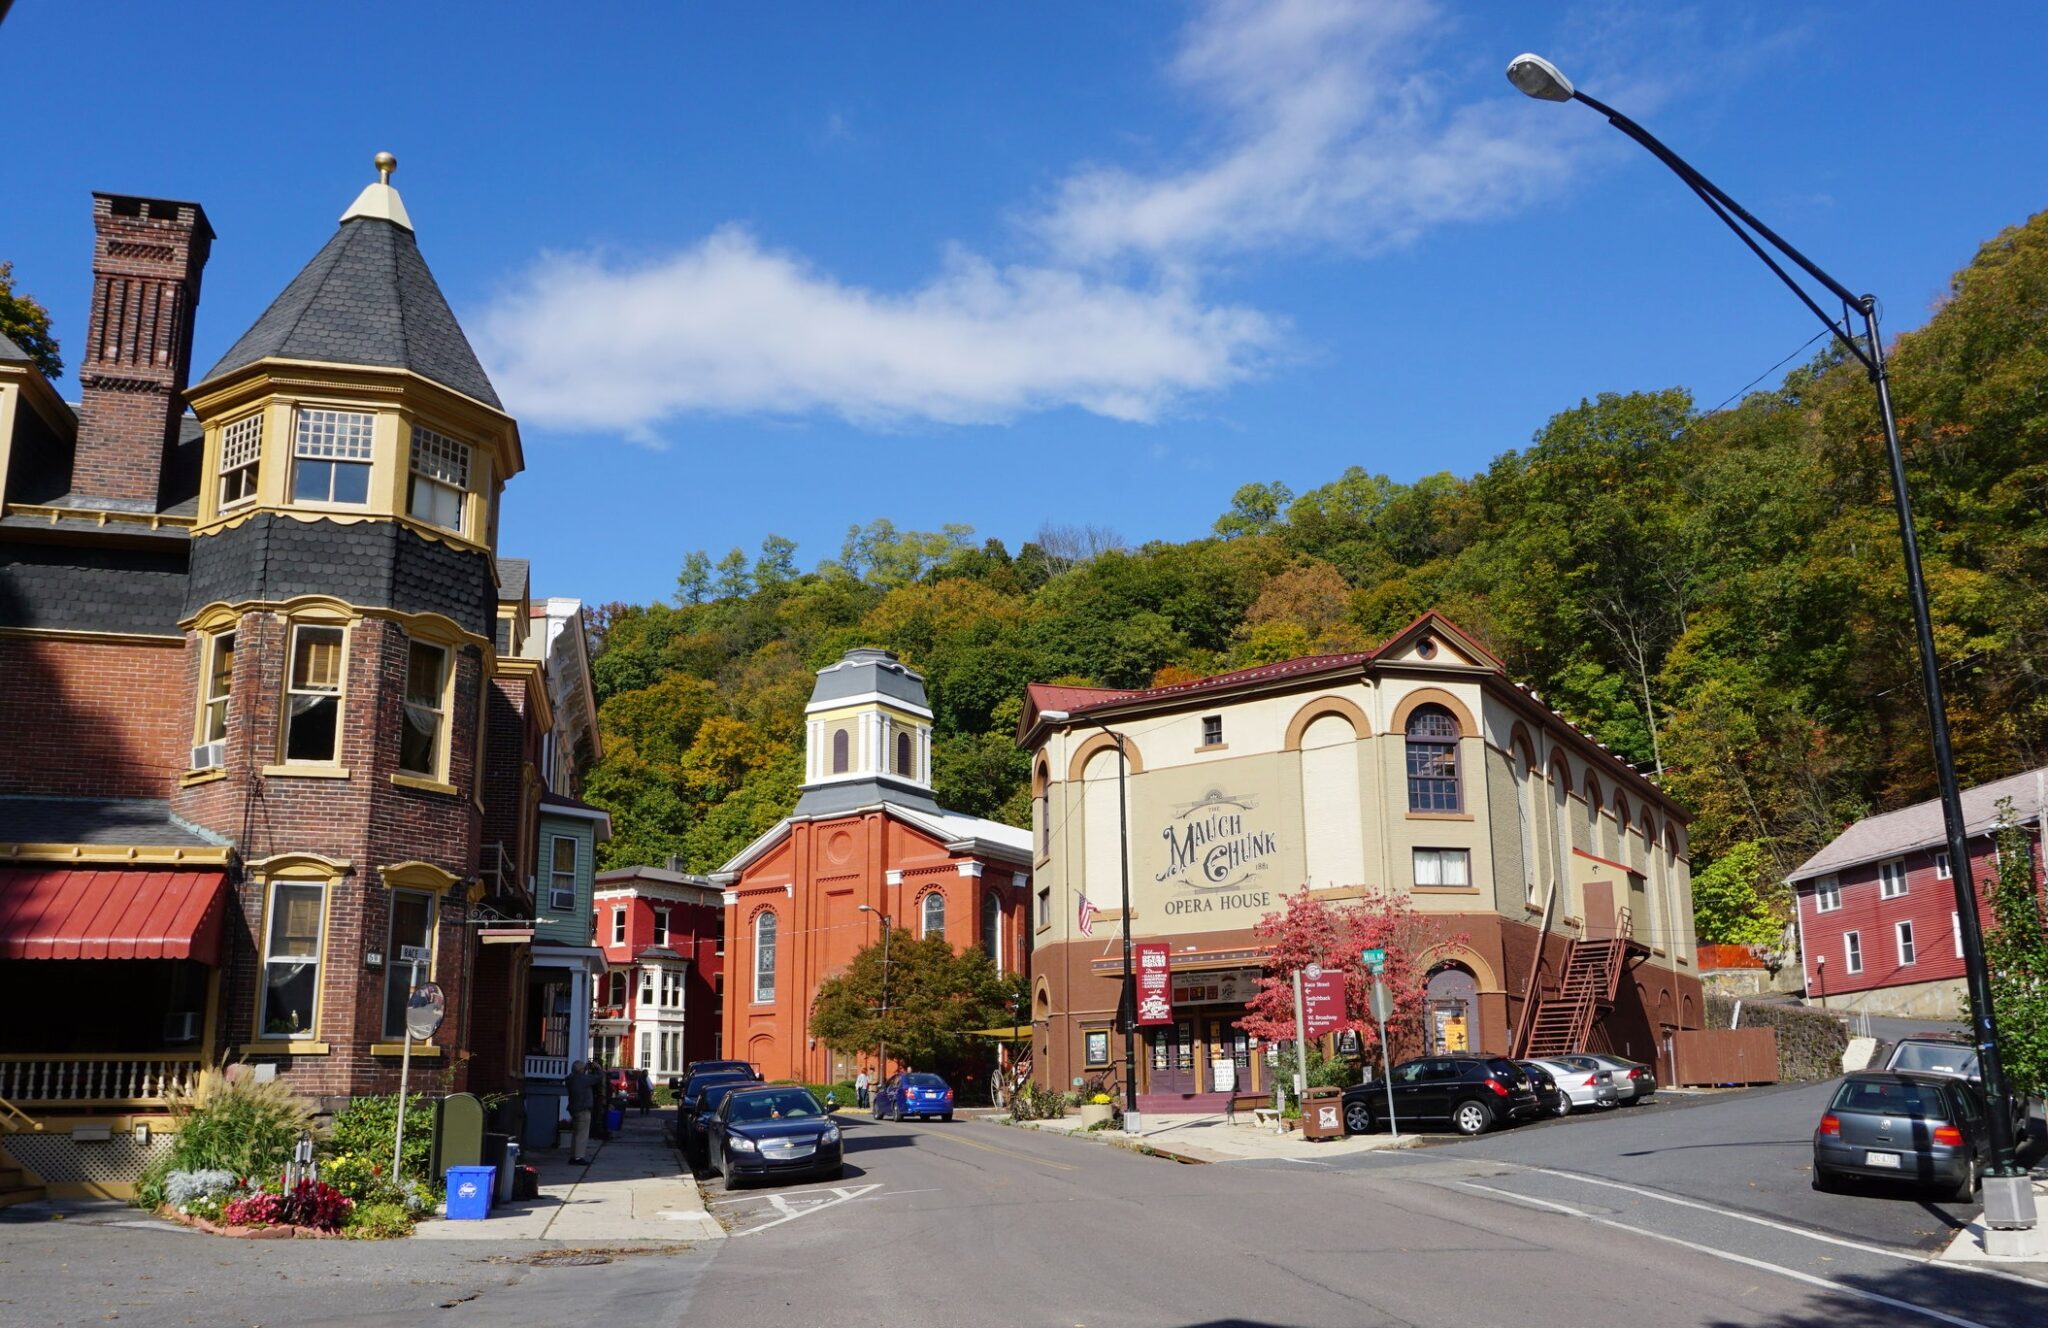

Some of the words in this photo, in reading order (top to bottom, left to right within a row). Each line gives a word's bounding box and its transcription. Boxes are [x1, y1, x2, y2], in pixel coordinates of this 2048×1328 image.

[1156, 814, 1241, 881] MAUCH
[1203, 830, 1276, 882] CHUNK
[1255, 862, 1268, 871] 1881
[1165, 898, 1213, 915] OPERA
[1220, 891, 1271, 910] HOUSE
[404, 947, 419, 958] RACE
